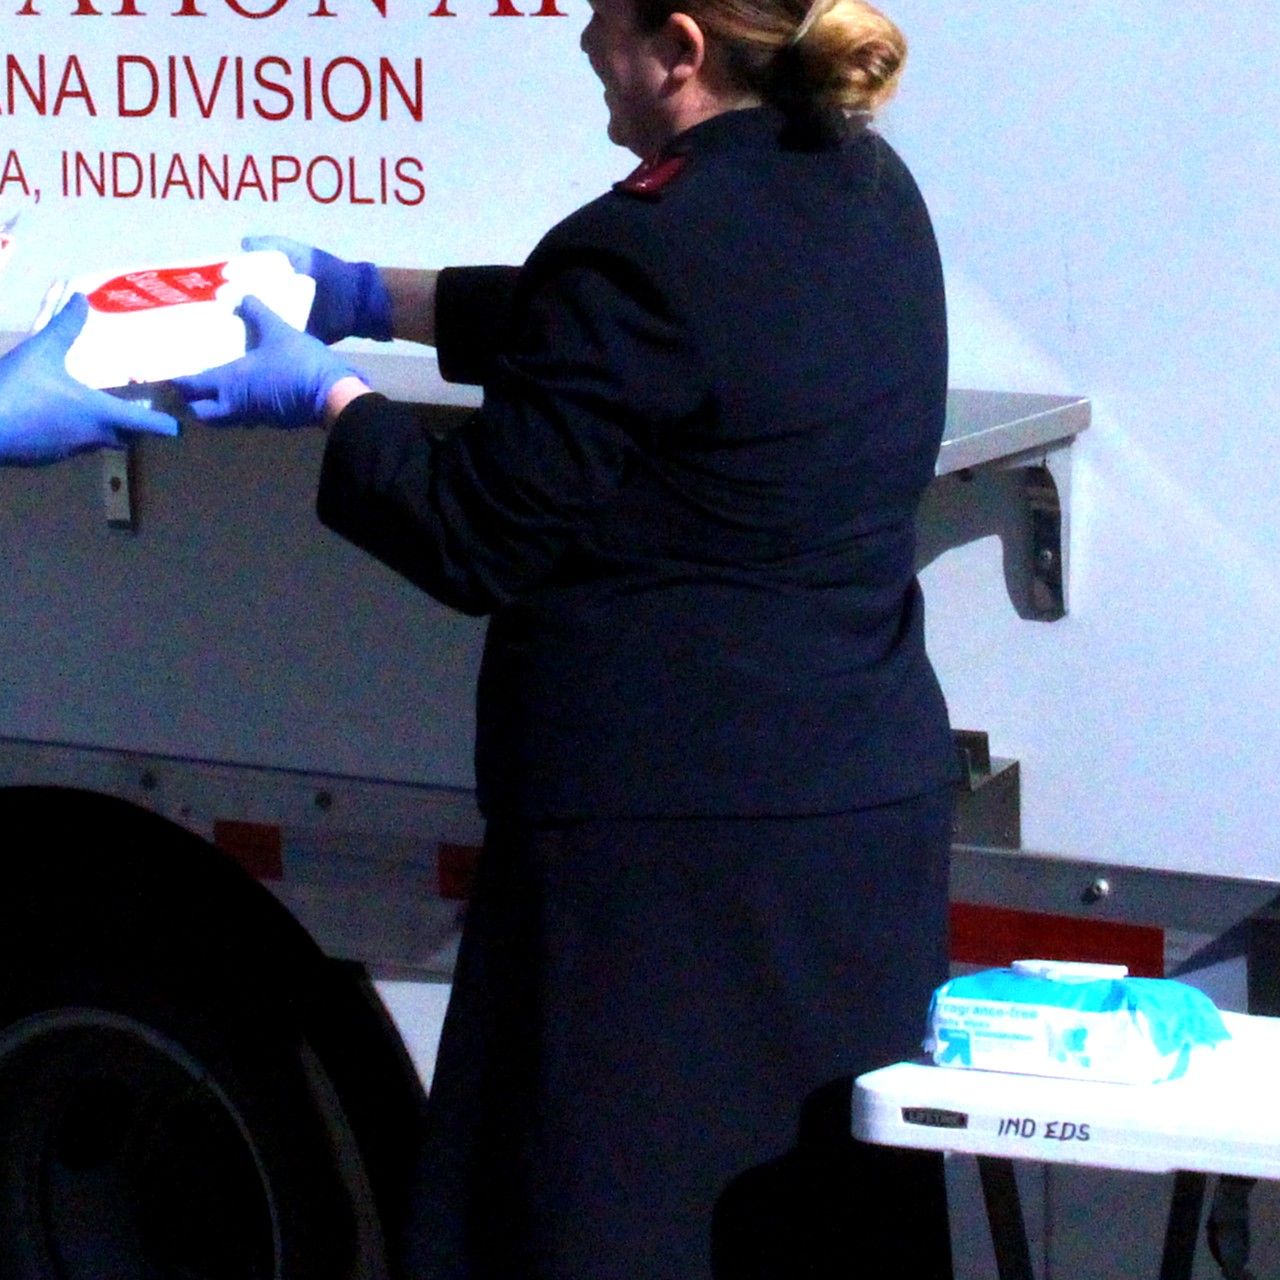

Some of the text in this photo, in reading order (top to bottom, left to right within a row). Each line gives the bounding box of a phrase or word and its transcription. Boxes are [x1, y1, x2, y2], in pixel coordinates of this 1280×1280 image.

[119, 54, 424, 123] DIVISION
[62, 151, 427, 207] INDIANAPOLIS
[998, 1118, 1091, 1141] IND EDS
